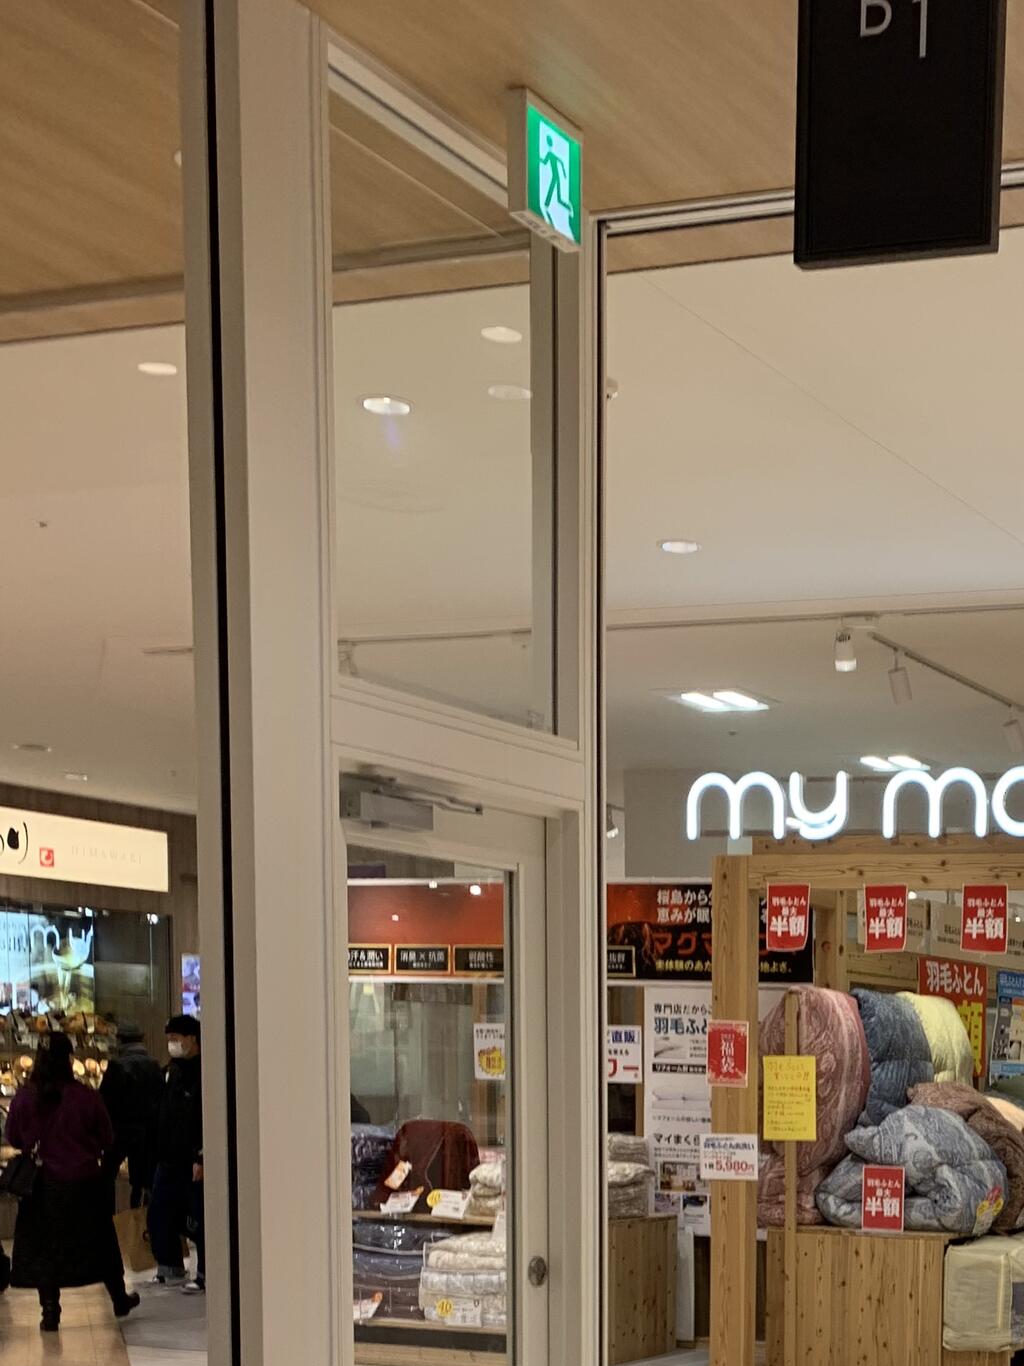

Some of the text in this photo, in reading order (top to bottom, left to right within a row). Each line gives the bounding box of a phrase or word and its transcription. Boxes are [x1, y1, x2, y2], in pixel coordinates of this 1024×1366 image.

[687, 770, 848, 841] my
[657, 906, 712, 924] 恵みが眠
[769, 915, 805, 937] 半額
[868, 916, 903, 940] 半額
[965, 916, 1004, 940] 半額
[926, 960, 983, 996] 羽毛ふとん
[865, 1198, 900, 1217] 半額
